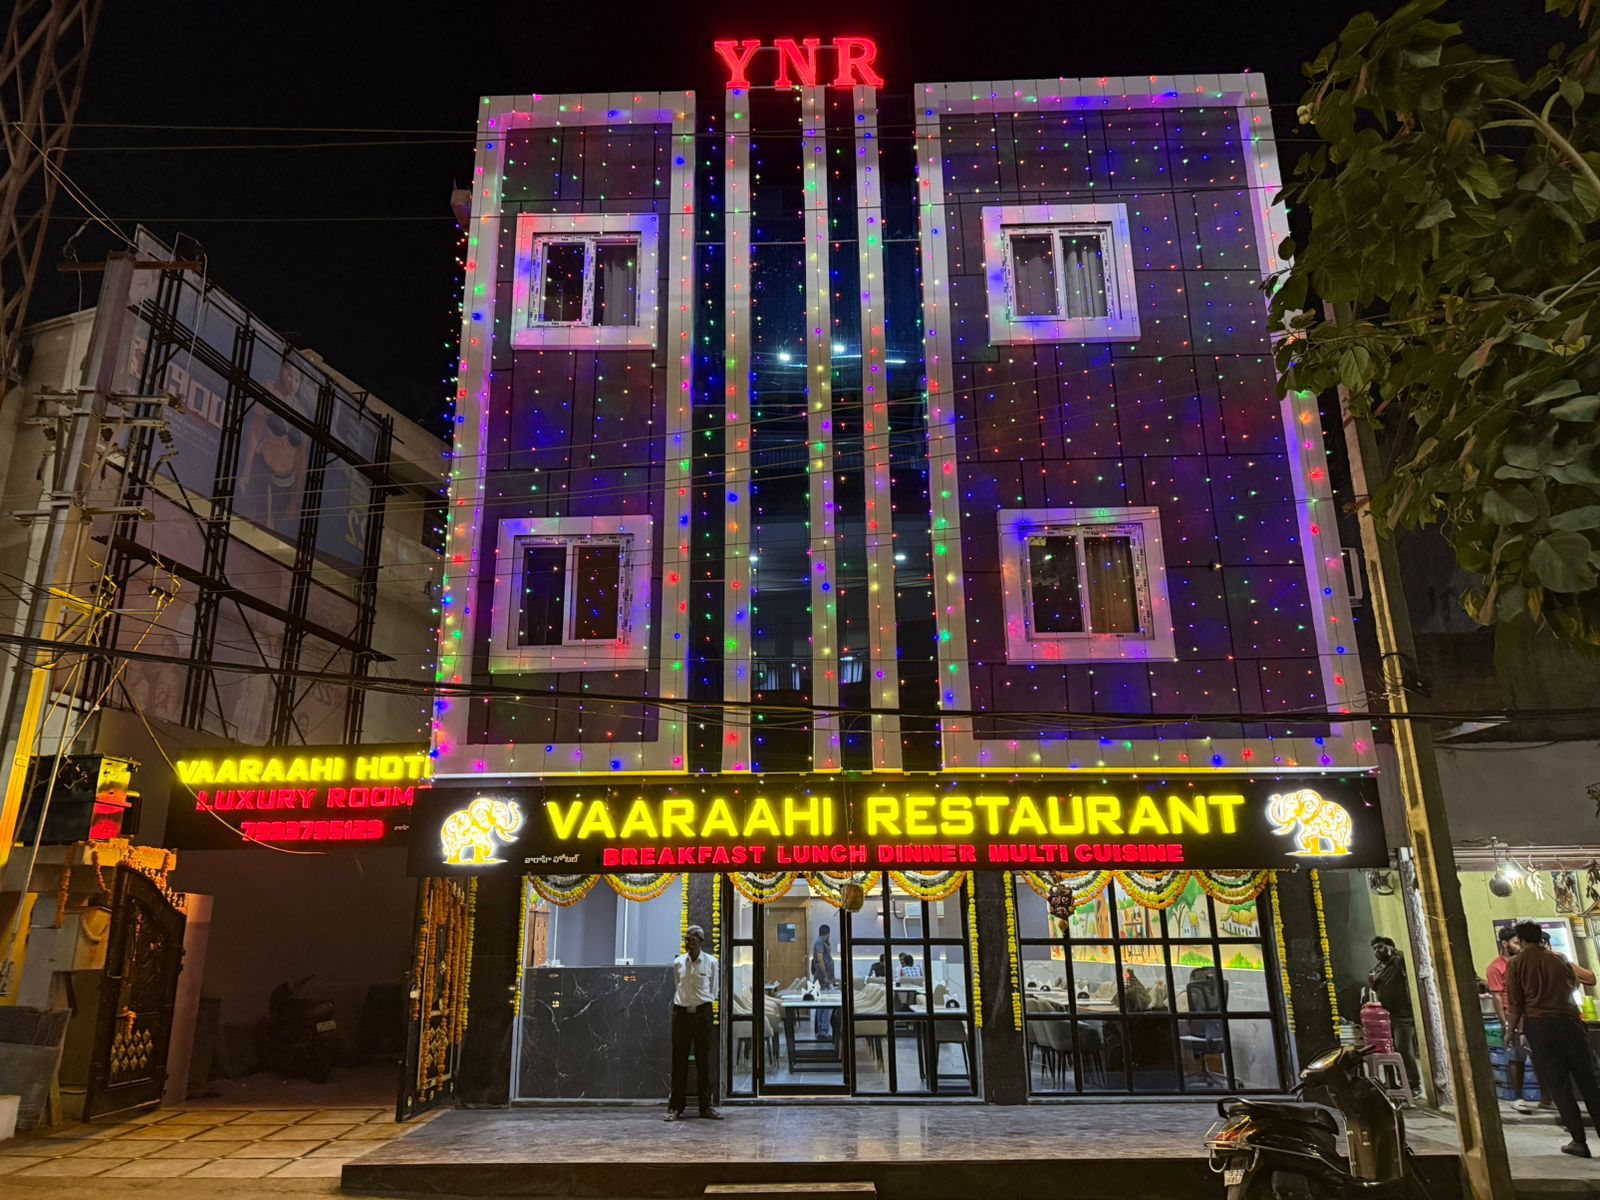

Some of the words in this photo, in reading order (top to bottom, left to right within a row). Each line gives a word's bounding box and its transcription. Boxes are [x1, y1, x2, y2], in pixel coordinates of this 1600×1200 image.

[714, 37, 884, 90] YNR
[177, 757, 344, 784] VAARAAHI
[196, 787, 318, 811] LUXURY
[546, 797, 833, 839] VAARAAHI
[866, 794, 1245, 836] RESTAURANT
[603, 846, 766, 866] BREAKFAST
[777, 845, 868, 864] LUNCH
[878, 844, 977, 863] DINNER
[988, 844, 1069, 863] MULTI
[1075, 844, 1185, 863] CUISINE
